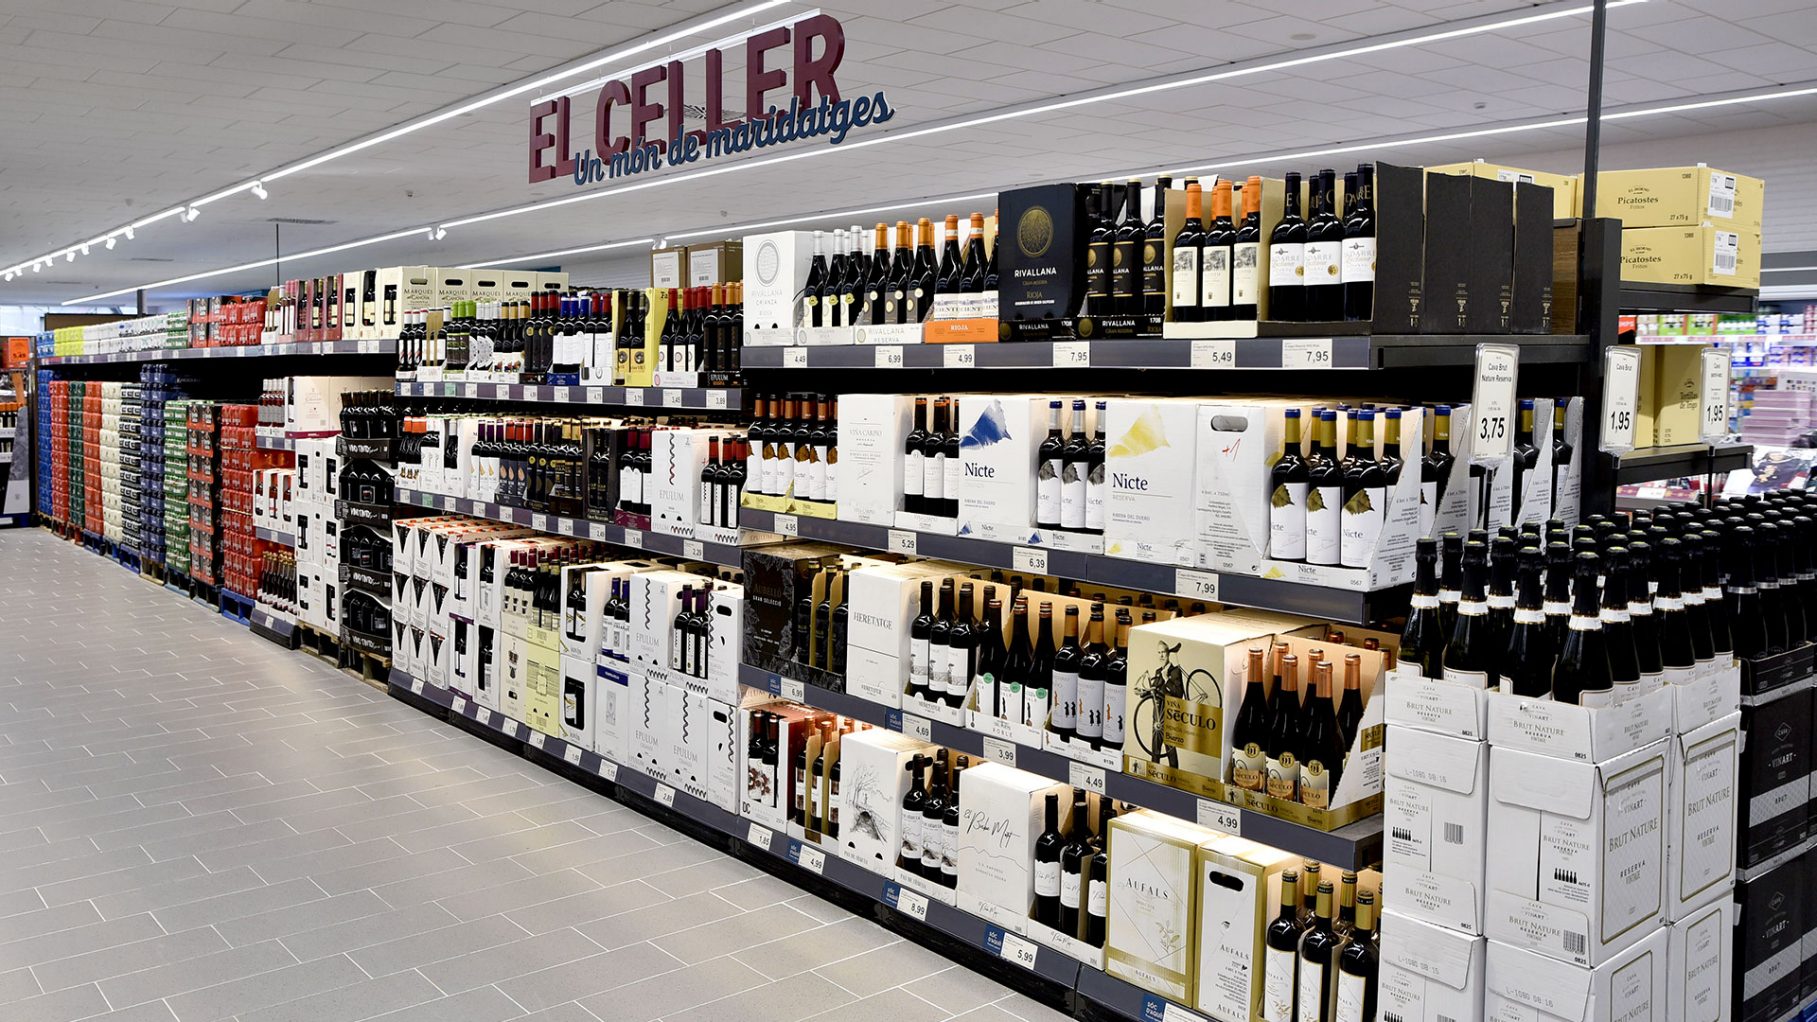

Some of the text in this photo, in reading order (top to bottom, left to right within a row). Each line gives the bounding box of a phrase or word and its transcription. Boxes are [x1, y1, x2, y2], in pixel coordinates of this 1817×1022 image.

[529, 14, 845, 184] EL CELLER
[573, 91, 895, 186] Un món de maridatges
[1617, 196, 1658, 204] Picatostes
[1620, 256, 1661, 264] Picatostes
[1014, 267, 1057, 278] RIVALLANA
[958, 354, 973, 363] 4,99
[1071, 351, 1087, 363] 7,95
[1212, 352, 1232, 363] 5,49
[1306, 350, 1328, 363] 7,95
[1707, 405, 1723, 424] 1,95
[1610, 410, 1630, 434] 1,95
[1480, 416, 1505, 442] 3,75
[965, 462, 995, 478] Nicte
[1113, 473, 1148, 491] Nicte
[1343, 528, 1363, 539] Nicte
[902, 539, 914, 549] 5,29
[1137, 543, 1152, 551] Nicte
[1029, 558, 1045, 568] 6,39
[1298, 565, 1316, 574] Nicte
[1196, 582, 1215, 594] 7,99
[1406, 702, 1452, 715] BRUT NATURE
[1513, 720, 1564, 736] BRUT NATURE
[998, 749, 1014, 760] 3,99
[1085, 776, 1103, 788] 4,49
[1407, 801, 1429, 812] NATURE
[1688, 786, 1730, 816] BRUT NATURE
[1217, 815, 1238, 829] 4,99
[1609, 817, 1658, 852] BRUT NATURE
[1697, 825, 1720, 841] RESERVA
[1543, 835, 1590, 850] BRUT NATURE
[810, 858, 822, 868] 4,99
[1620, 860, 1646, 878] RESERVA
[1405, 888, 1451, 906] BRUT NATURE
[1509, 916, 1560, 936] BRUT NATURE
[1017, 949, 1033, 963] 5,99
[1381, 982, 1421, 1001] BRUT NATURE
